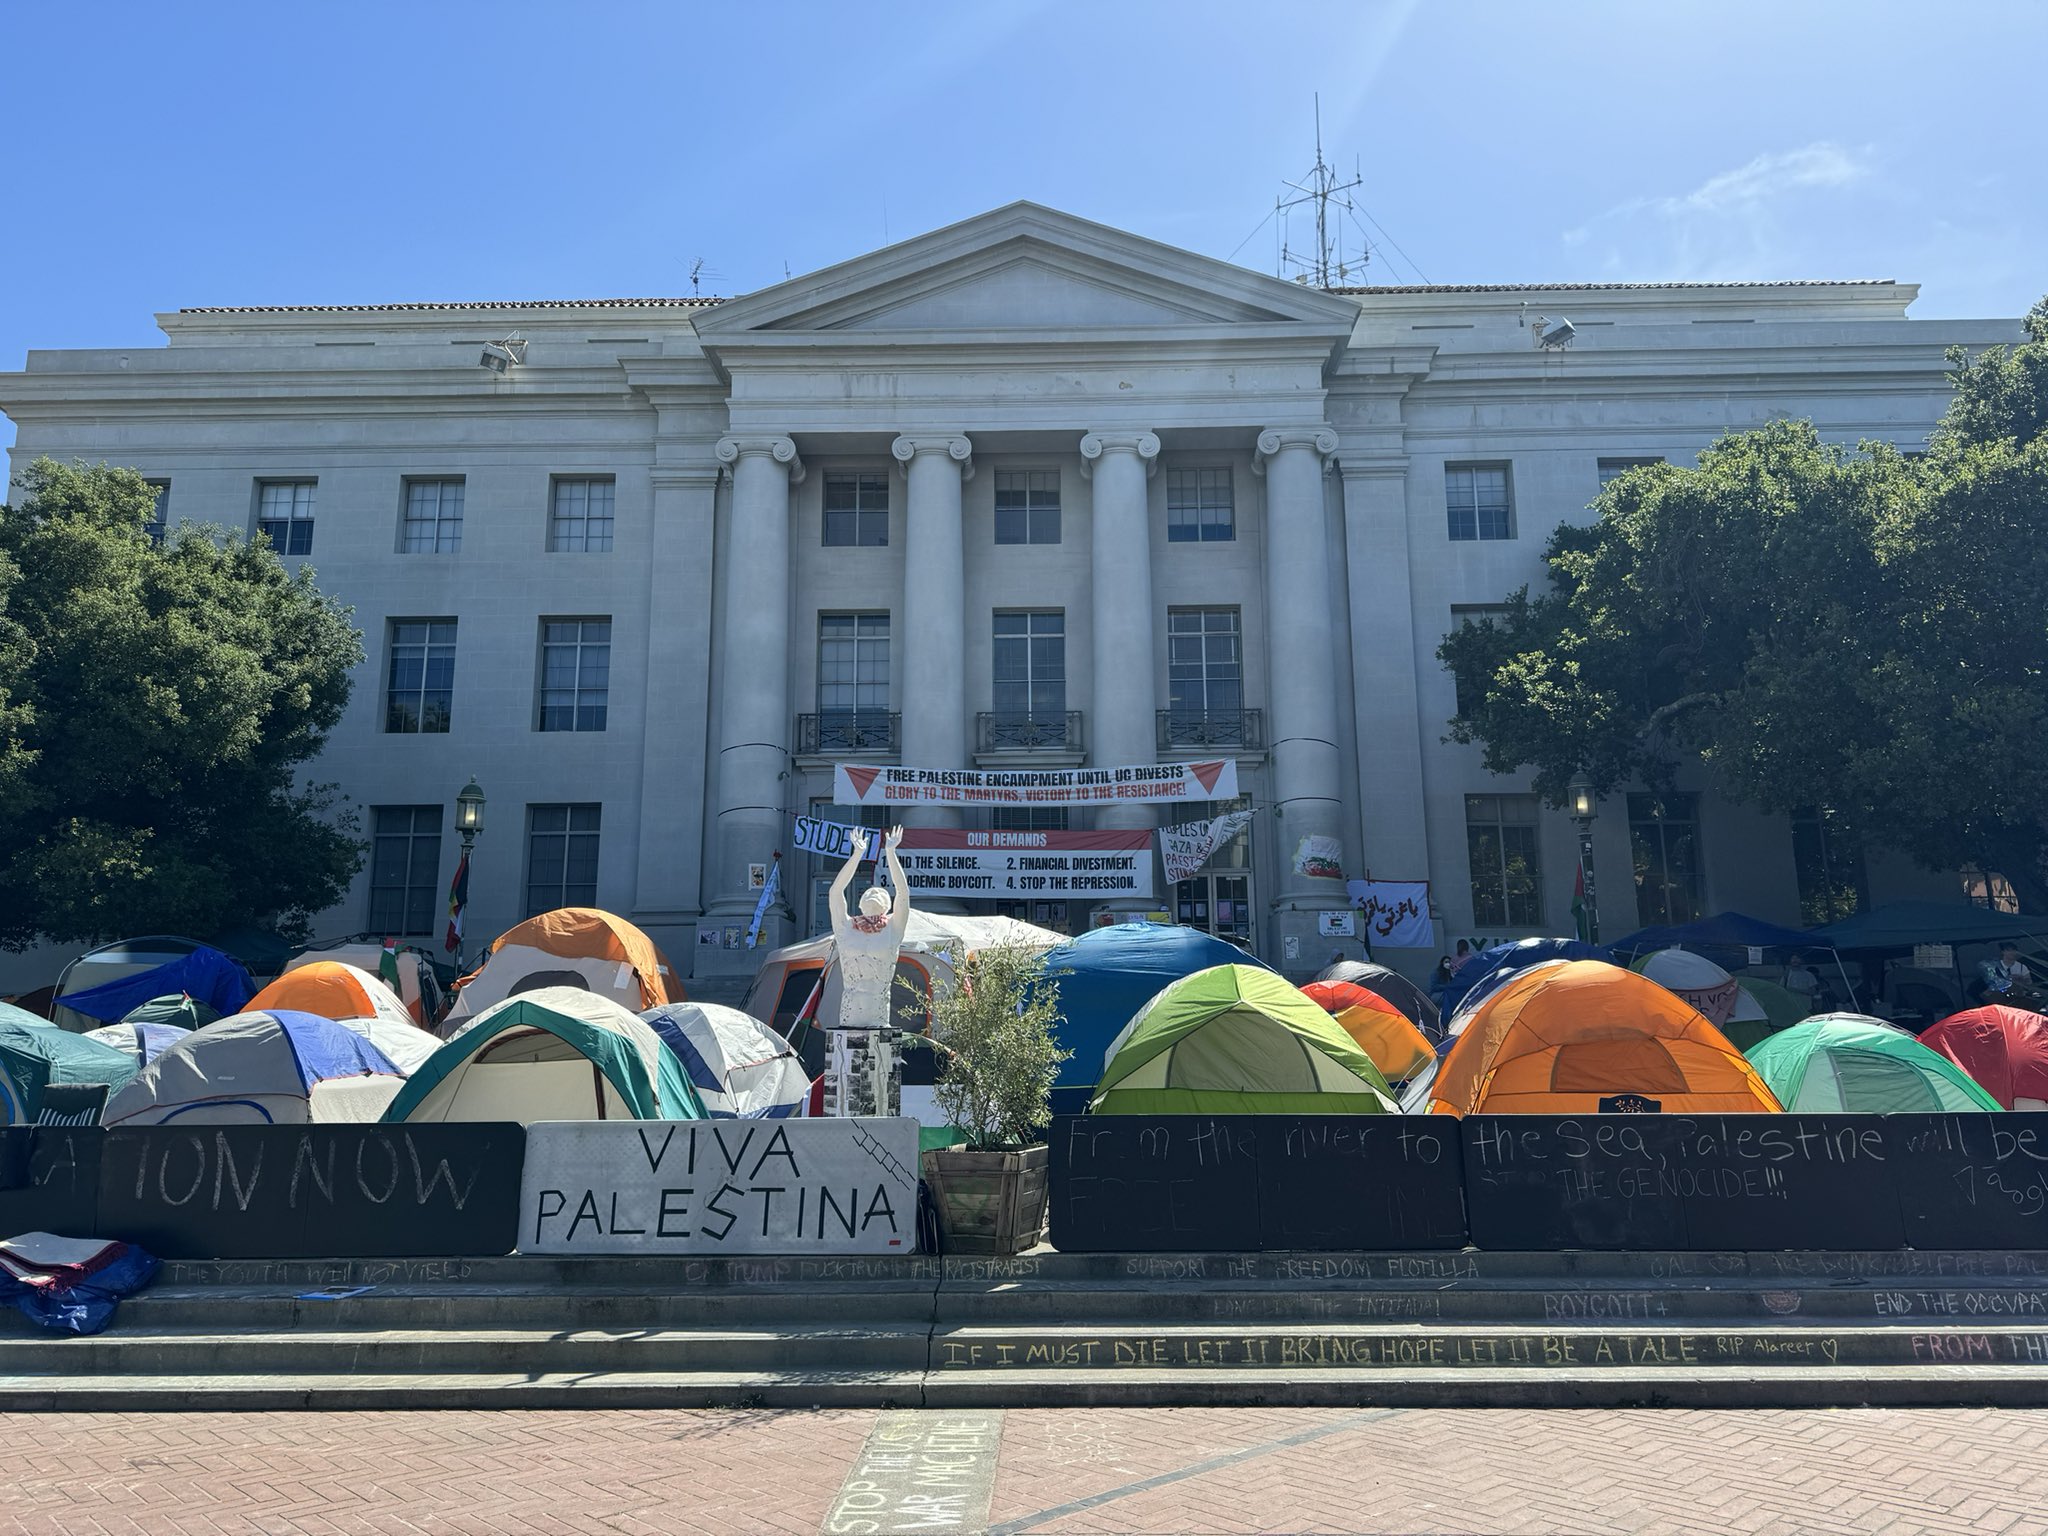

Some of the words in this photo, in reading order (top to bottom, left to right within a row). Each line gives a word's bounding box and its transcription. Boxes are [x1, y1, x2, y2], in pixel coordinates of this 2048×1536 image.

[886, 769, 915, 783] FREE
[918, 769, 982, 786] PALESTINE
[986, 772, 1073, 787] ENCAMPMENT
[1077, 771, 1111, 785] UNTIL
[1115, 768, 1132, 782] UC
[1135, 765, 1184, 781] DIVESTS
[885, 785, 920, 799] GLORY
[922, 787, 938, 799] TO
[940, 787, 961, 800] THE
[964, 788, 1022, 802] MARTYRS,
[1025, 788, 1073, 801] VICTORY
[1075, 787, 1090, 800] TO
[1092, 784, 1114, 799] THE
[1117, 782, 1187, 799] RESISTANCE!
[794, 817, 879, 860] STUDET
[967, 832, 989, 847] OUR
[992, 832, 1047, 848] DEMANDS
[915, 856, 934, 869] THE
[937, 857, 981, 870] SILENCE.
[1007, 857, 1017, 870] 2.
[1019, 857, 1070, 870] FINANCIAL
[1072, 857, 1137, 870] DIVESTMENT.
[881, 875, 890, 887] 3.
[893, 875, 945, 888] ADEMIC
[949, 876, 996, 889] BOYCOTT.
[1006, 876, 1017, 889] 4.
[1019, 876, 1046, 889] STOP
[1049, 876, 1068, 889] THE
[1071, 876, 1138, 889] REPRESSION.
[637, 1124, 801, 1181] VIVA
[1068, 1118, 1171, 1170] Frm
[1186, 1118, 1258, 1168] the
[1283, 1121, 1375, 1161] river
[1395, 1118, 1442, 1165] to
[1471, 1120, 1551, 1166] the
[1987, 1113, 2048, 1161] be
[290, 1128, 483, 1212] NOW
[1556, 1167, 1612, 1201] THE
[1617, 1165, 1788, 1201] GENOCIDE!!!
[535, 1182, 898, 1246] PALESTINA
[171, 1264, 209, 1283] THE
[215, 1263, 288, 1284] YOUTH
[1126, 1257, 1208, 1281] SUPPORT
[1227, 1258, 1258, 1279] THE
[1274, 1257, 1372, 1281] FREEDOM
[1387, 1256, 1481, 1280] FLOTILLA
[1543, 1294, 1653, 1320] BOYCOTT
[1873, 1292, 1913, 1315] END
[1916, 1293, 1960, 1315] THE
[1964, 1291, 2048, 1315] OCCUPA
[942, 1342, 984, 1367] IF
[996, 1343, 1017, 1367] I
[1025, 1339, 1103, 1366] MUST
[1183, 1339, 1231, 1364] LET
[1240, 1338, 1270, 1365] IT
[1280, 1337, 1372, 1367] BRING
[1457, 1337, 1500, 1364] LET
[1506, 1337, 1534, 1363] IT
[1542, 1336, 1579, 1364] BE
[1594, 1336, 1614, 1364] A
[1619, 1335, 1697, 1363] TALE
[1716, 1336, 1745, 1356] RIP
[1753, 1338, 1815, 1356] Alareer
[1911, 1333, 1995, 1361] FROM
[912, 1419, 989, 1487] MACHINE
[830, 1480, 891, 1534] STOP
[861, 1453, 916, 1477] THE
[892, 1493, 971, 1530] WAR
